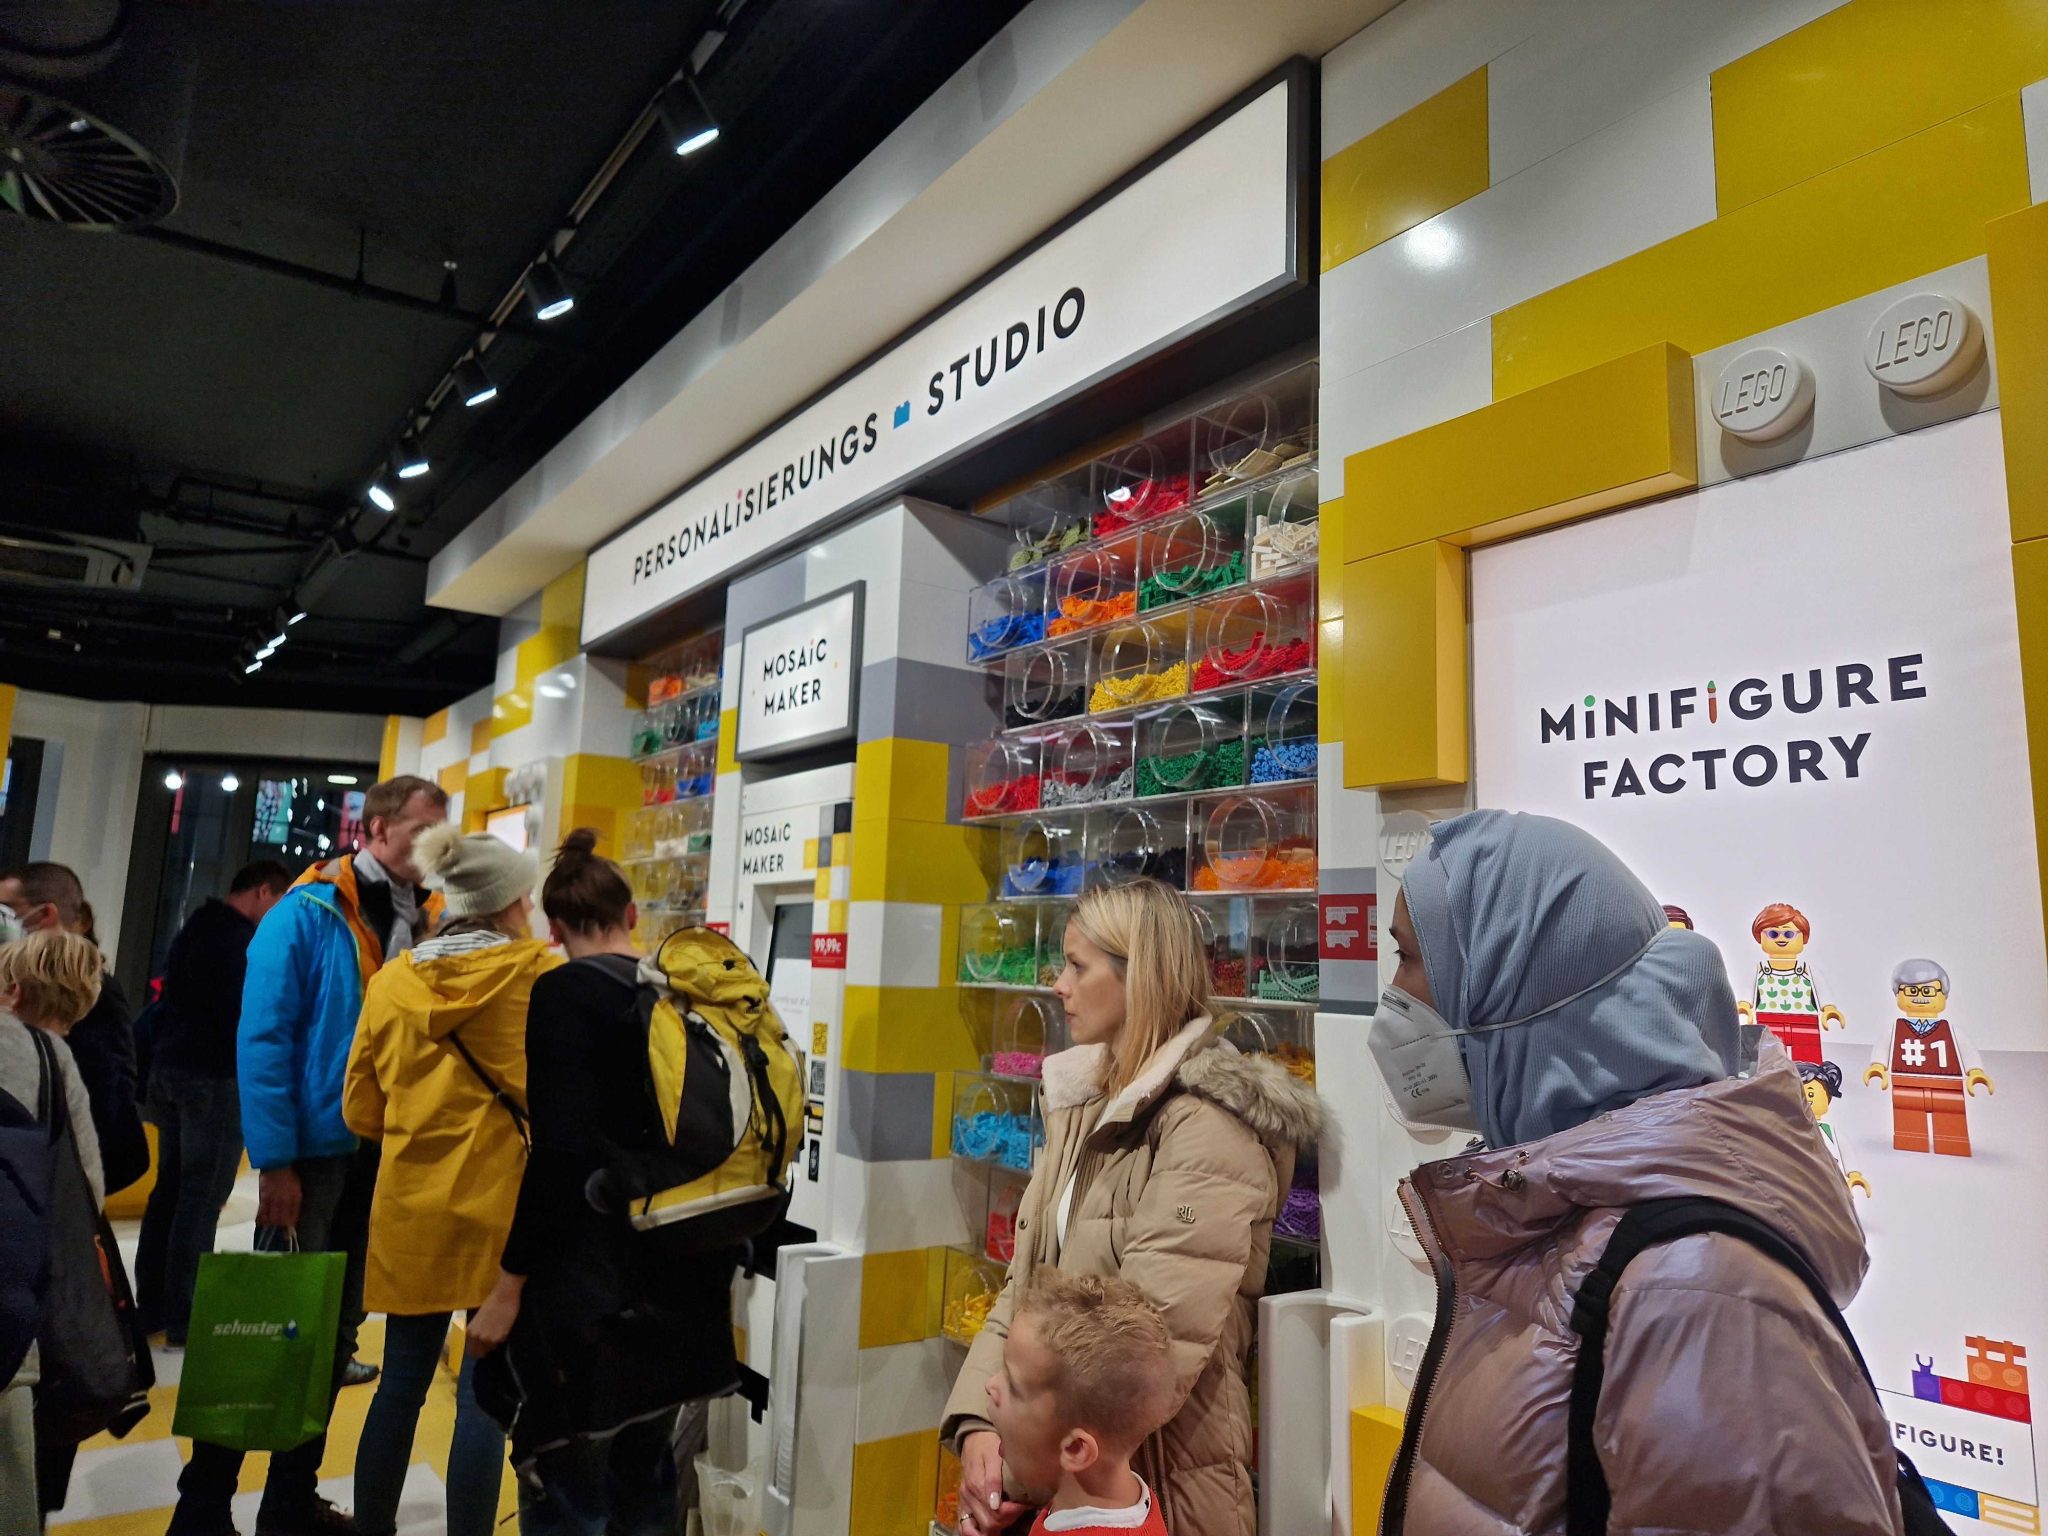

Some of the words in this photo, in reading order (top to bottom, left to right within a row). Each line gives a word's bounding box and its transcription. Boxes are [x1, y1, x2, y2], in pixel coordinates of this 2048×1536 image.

[926, 286, 1086, 416] STUDIO
[1874, 310, 1953, 371] LEGO
[1719, 364, 1787, 419] LEGO
[763, 678, 822, 717] MAKER
[1583, 732, 1872, 800] FACTORY
[743, 853, 784, 876] MAKER
[1900, 1038, 1948, 1068] #1
[212, 1318, 283, 1336] schuster
